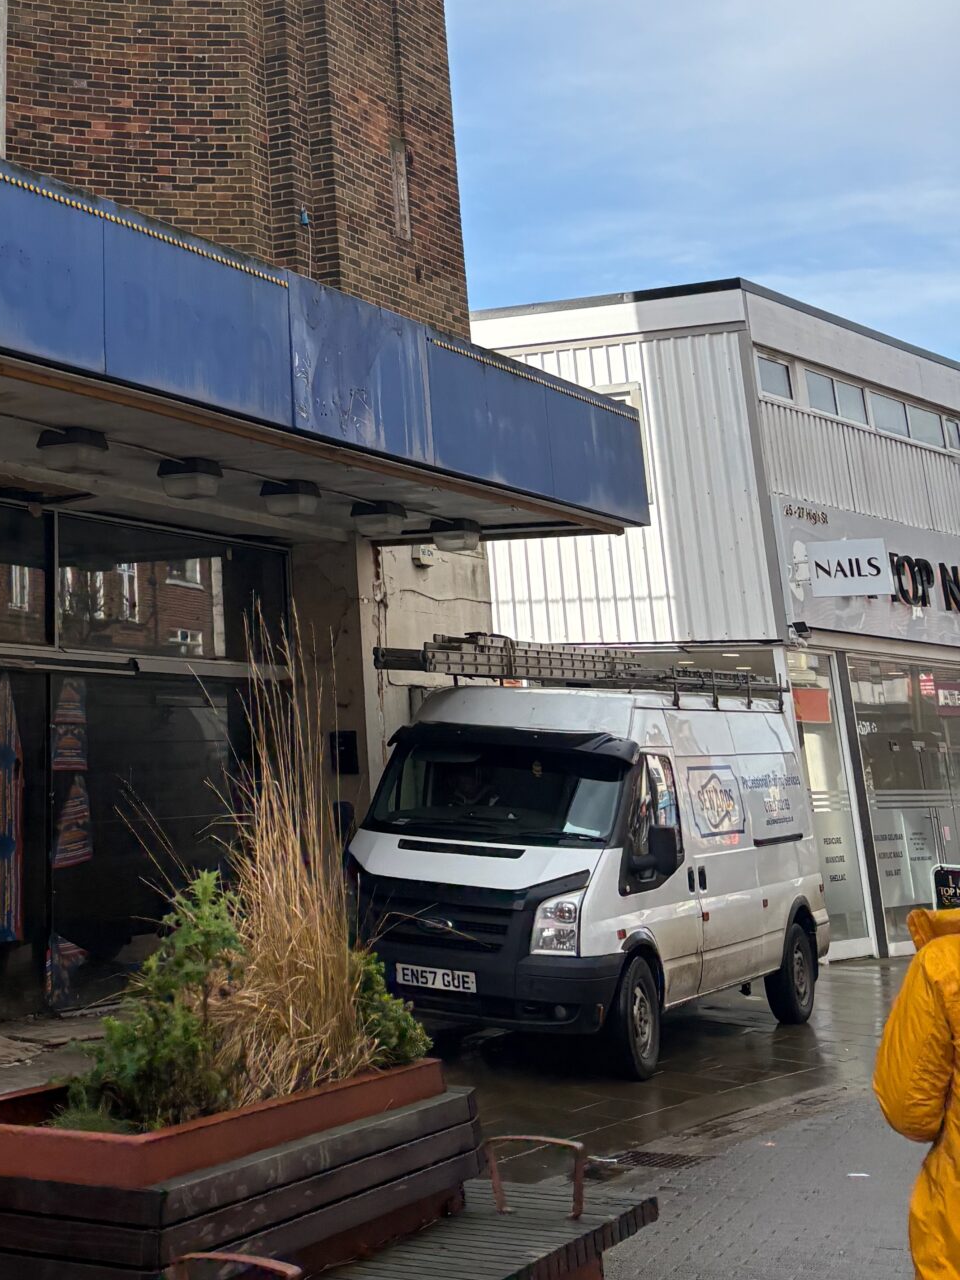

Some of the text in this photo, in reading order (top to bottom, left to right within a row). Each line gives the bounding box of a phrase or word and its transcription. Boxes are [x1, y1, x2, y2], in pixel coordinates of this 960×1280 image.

[814, 556, 881, 579] NAILS
[402, 967, 471, 990] EN57 GUE
